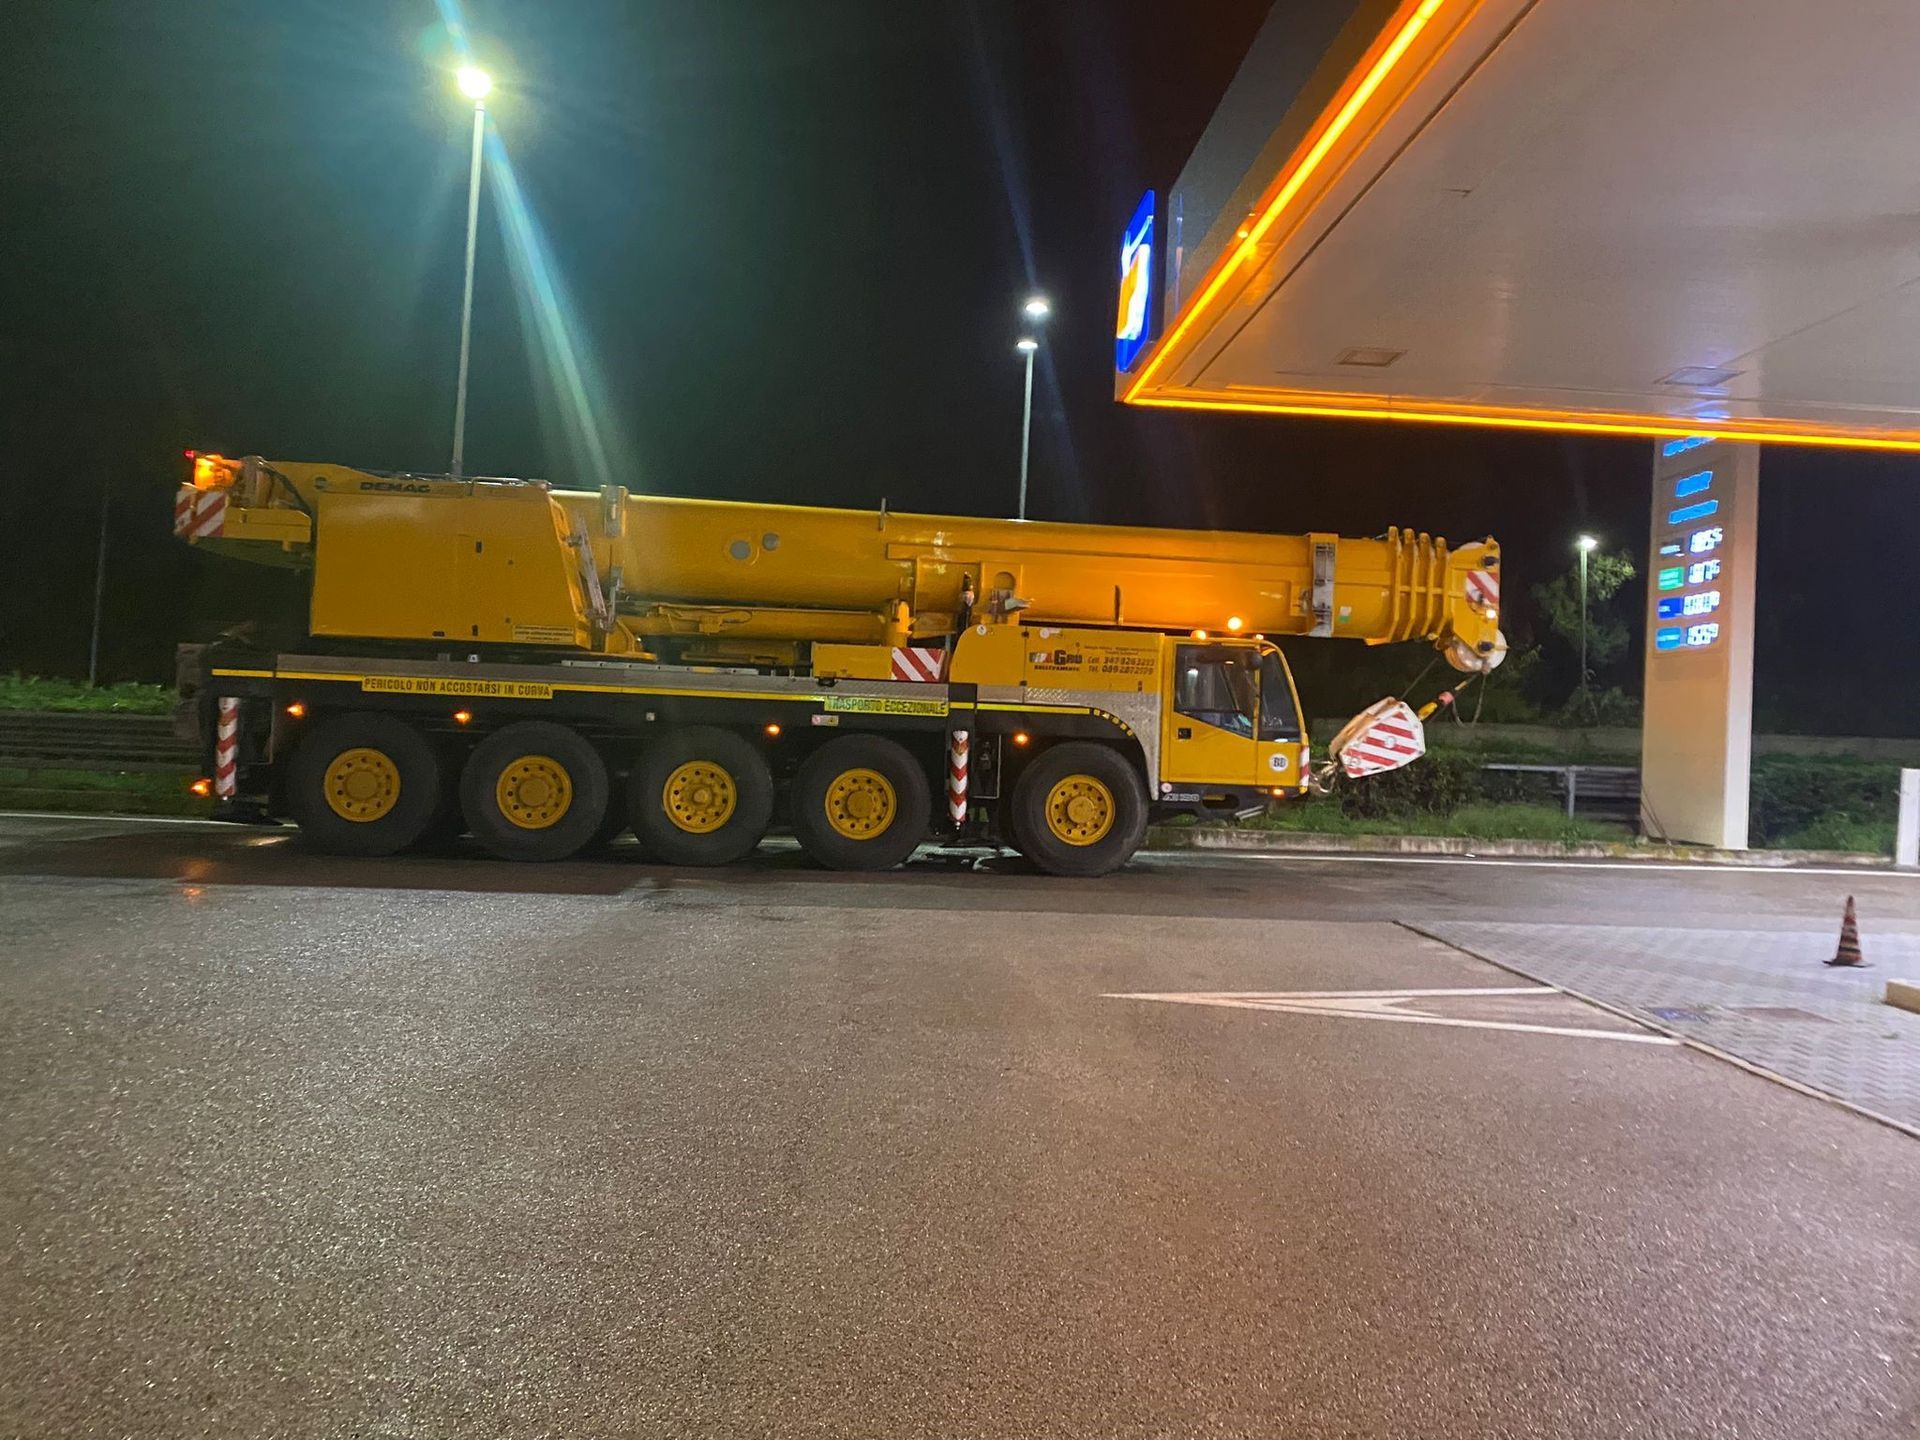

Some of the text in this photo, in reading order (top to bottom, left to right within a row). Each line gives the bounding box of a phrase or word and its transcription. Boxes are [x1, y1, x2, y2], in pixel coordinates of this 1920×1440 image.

[360, 481, 431, 493] DEMAG
[364, 678, 550, 696] PERICOLO NON ACCOSTARSI IN CURVA
[884, 699, 946, 715] ECCEZIONALE
